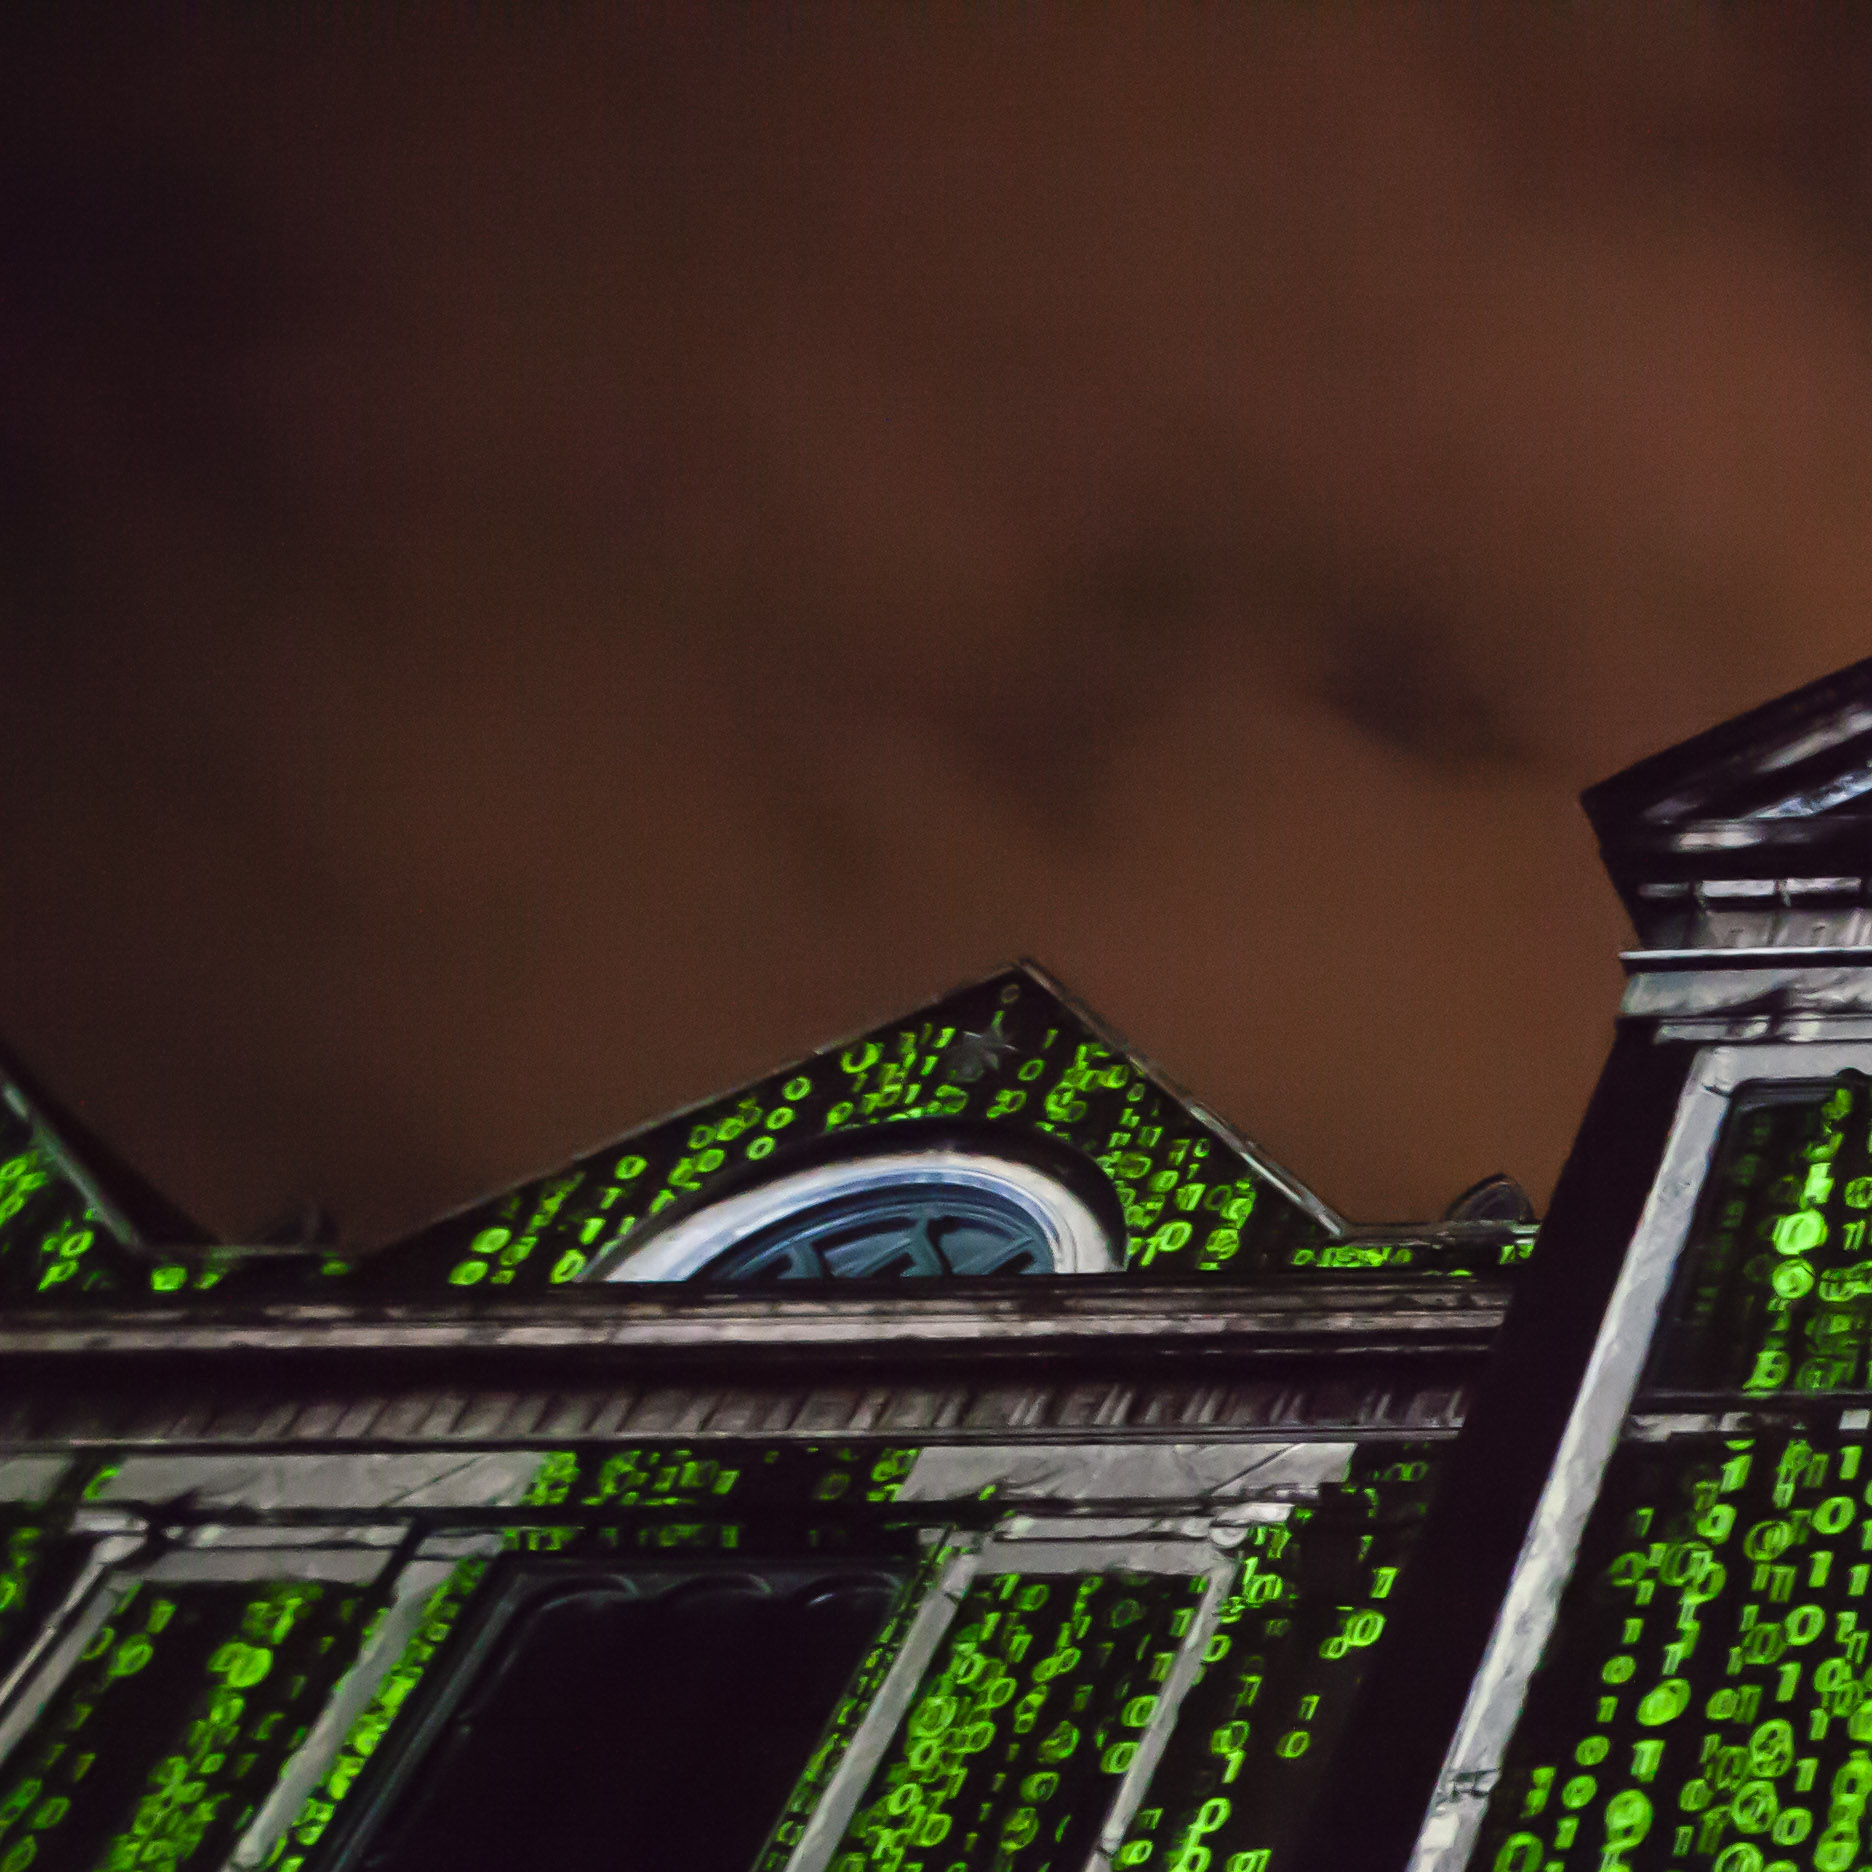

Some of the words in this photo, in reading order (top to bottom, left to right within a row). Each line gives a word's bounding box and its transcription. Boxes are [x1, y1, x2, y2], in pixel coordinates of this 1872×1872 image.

[1840, 1445, 1863, 1479] 1
[1849, 1564, 1870, 1595] 1
[1777, 1662, 1801, 1701] 1
[1797, 1759, 1817, 1790] 1
